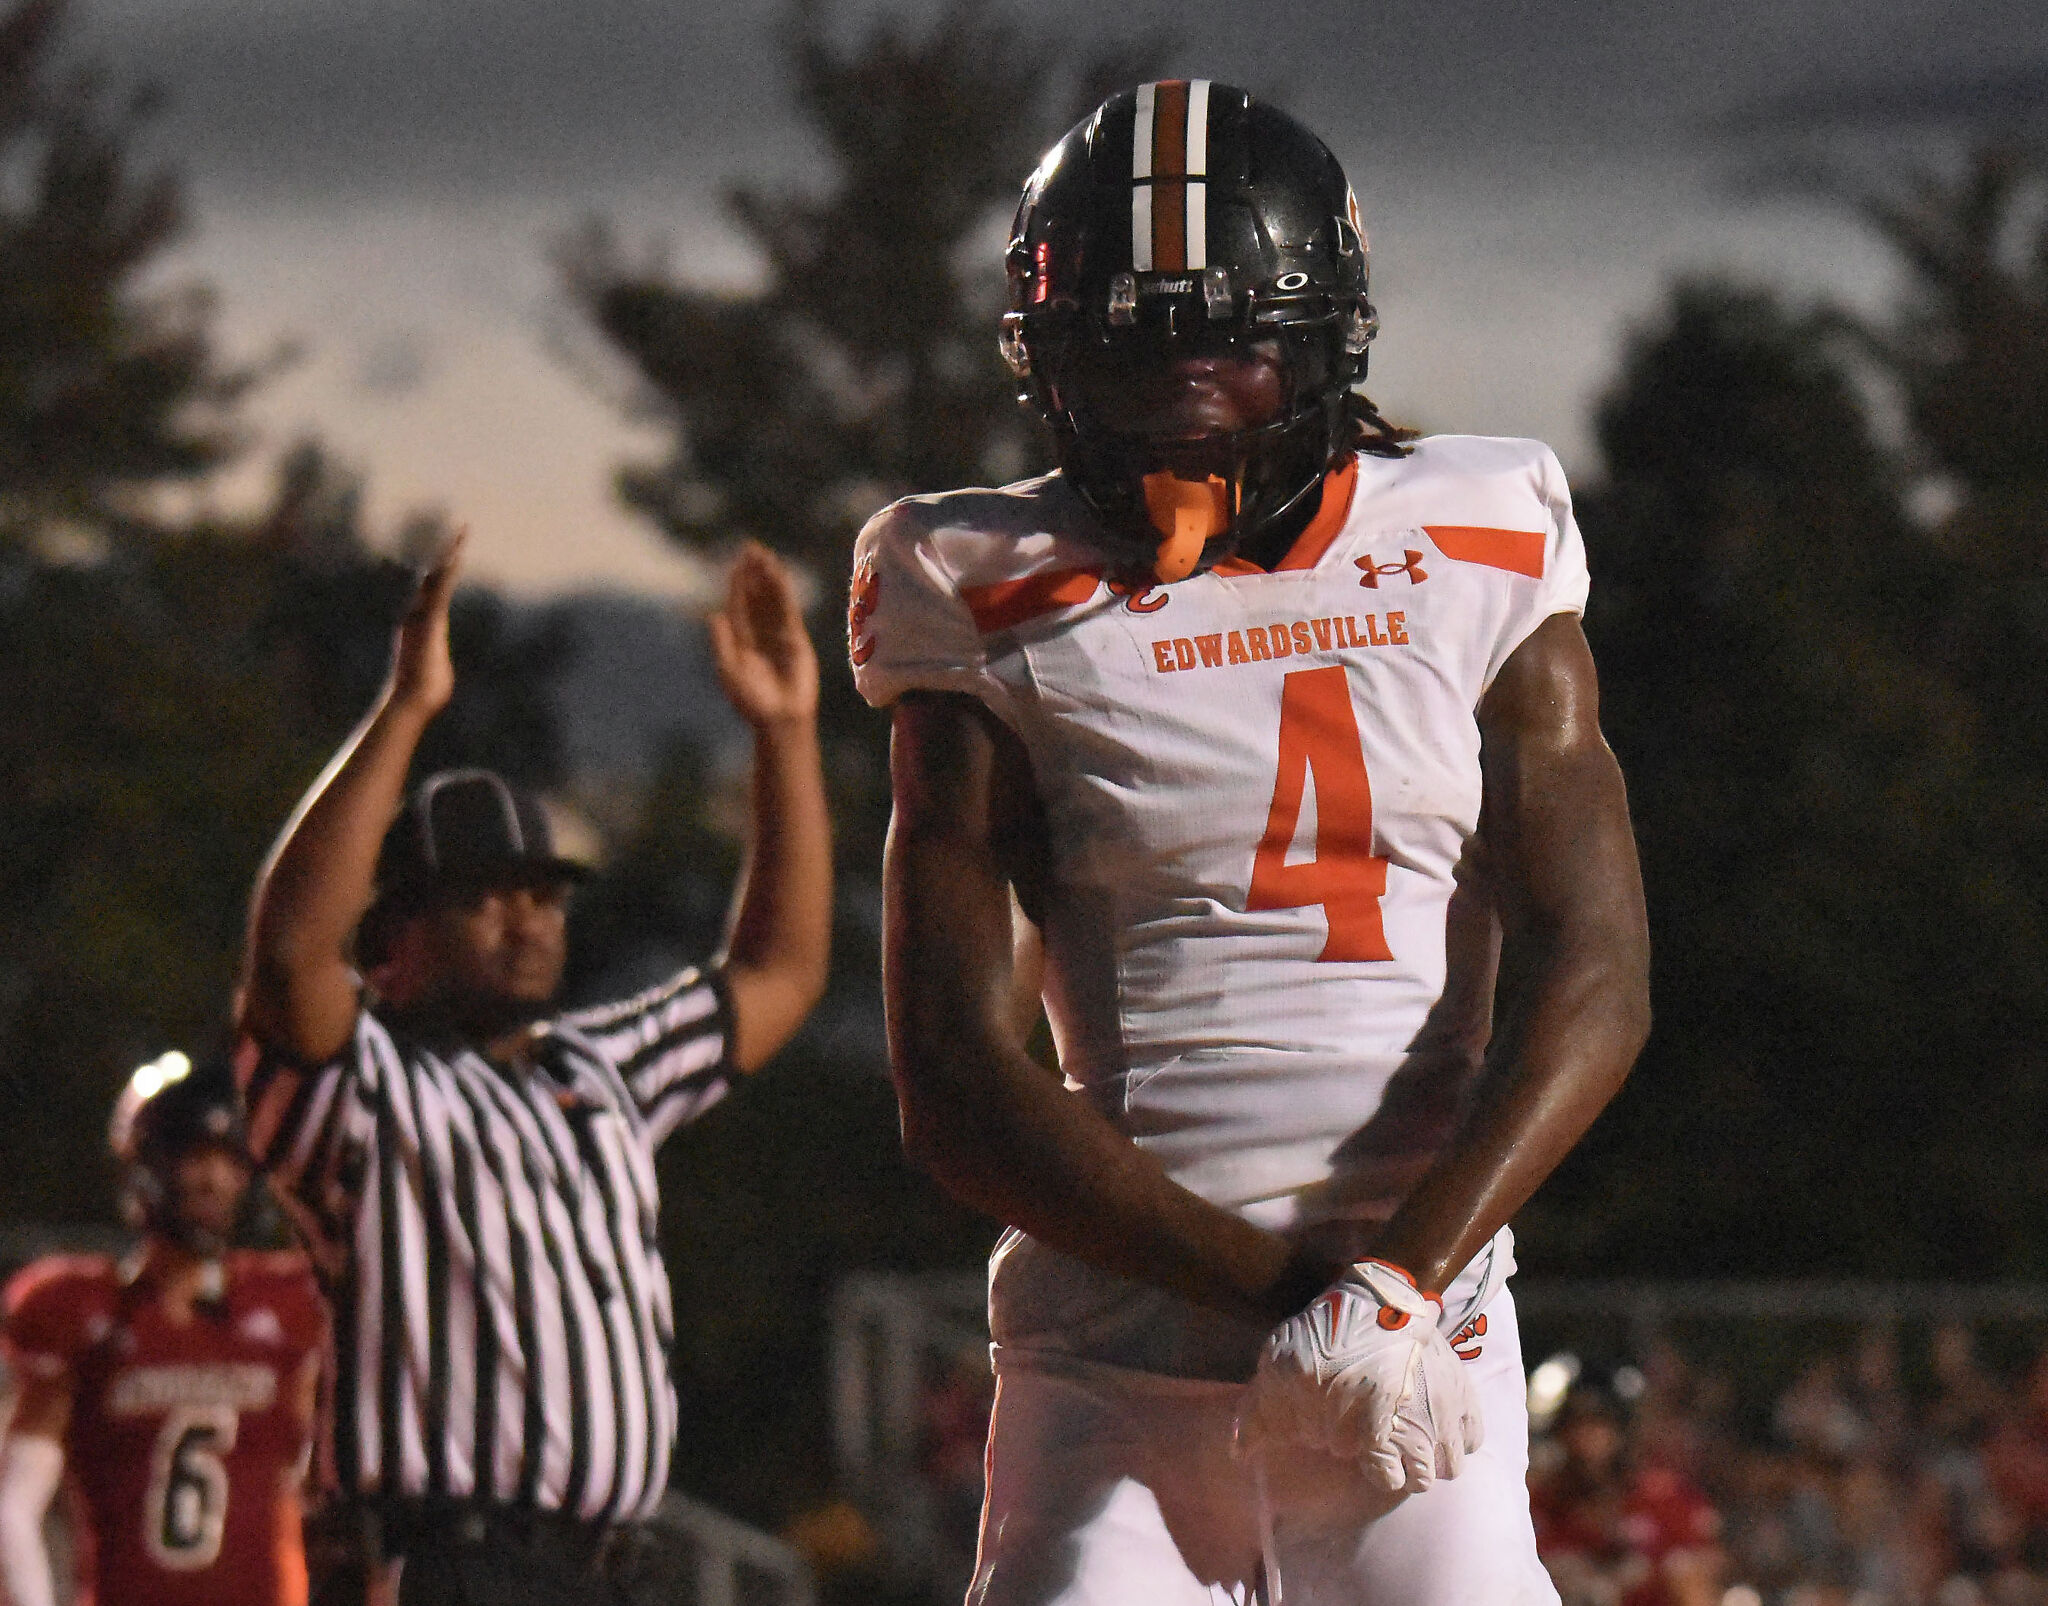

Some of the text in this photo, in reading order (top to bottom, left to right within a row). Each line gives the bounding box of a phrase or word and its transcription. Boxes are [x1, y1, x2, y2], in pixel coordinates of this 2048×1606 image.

[1151, 611, 1409, 673] EDWARDSVILLE
[1246, 665, 1395, 962] 4
[148, 1406, 237, 1569] 6
